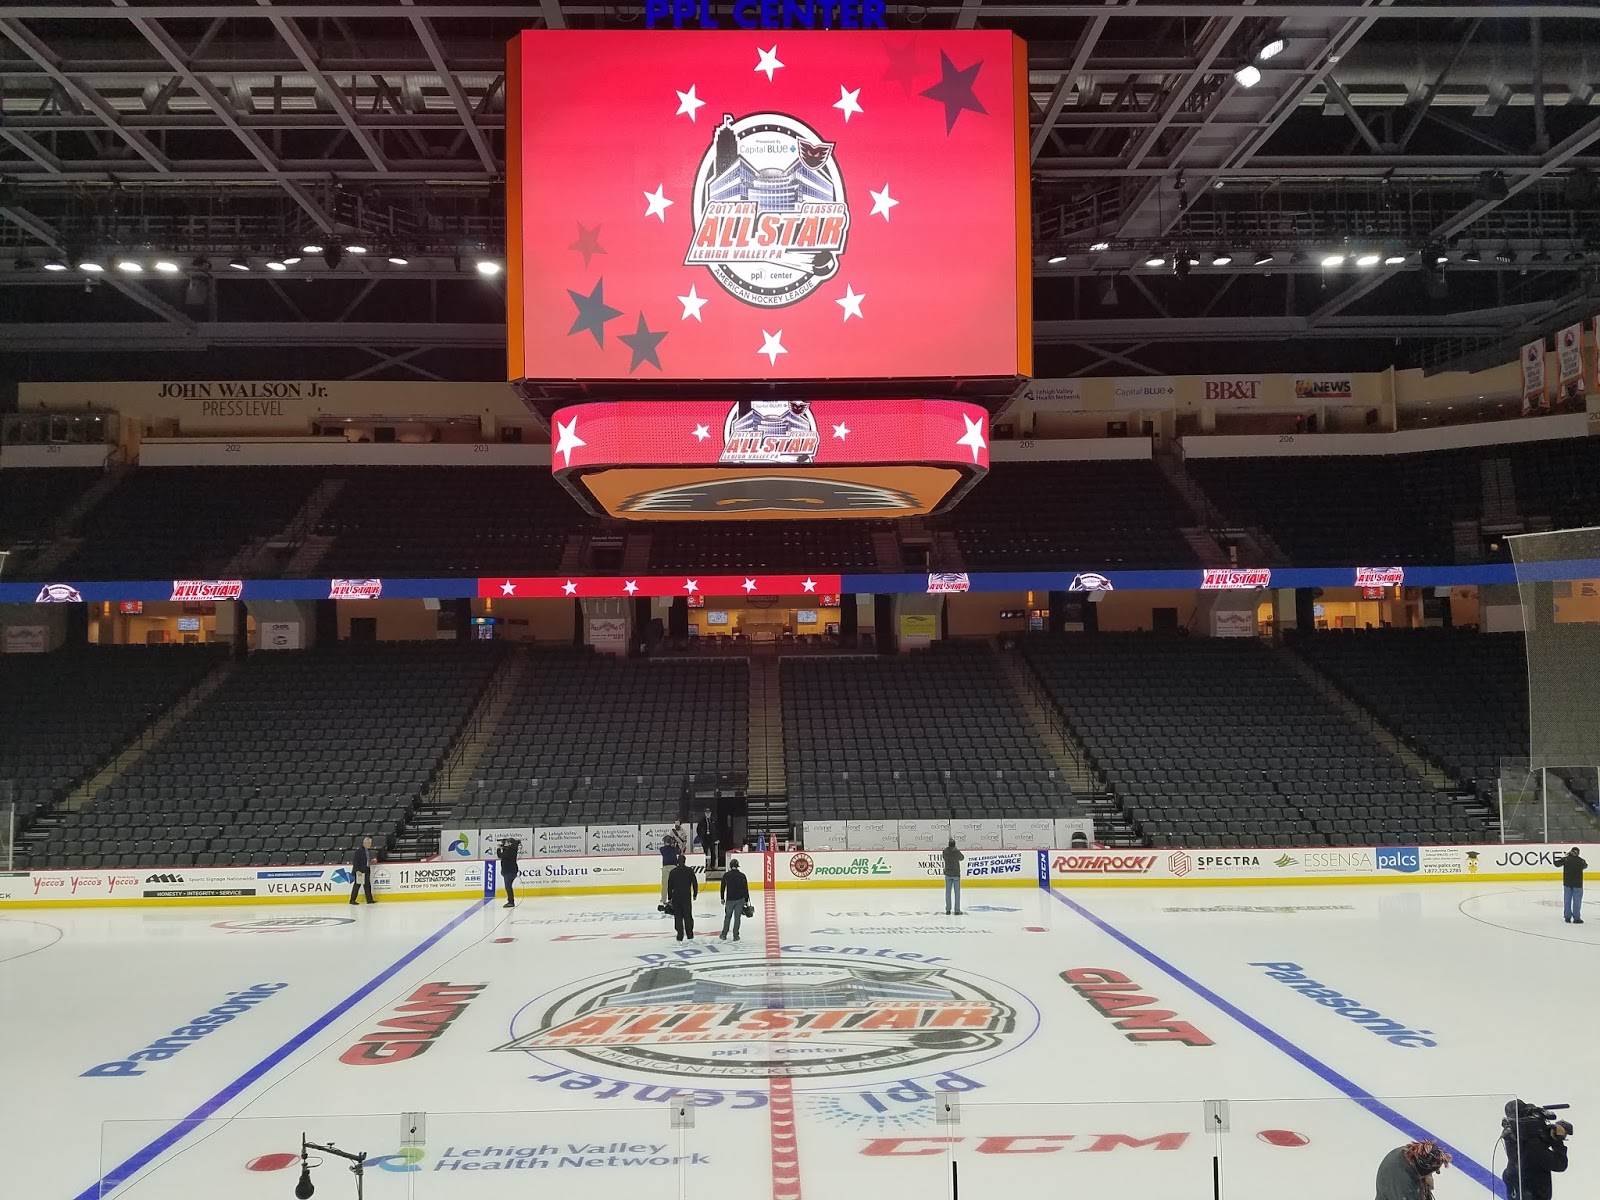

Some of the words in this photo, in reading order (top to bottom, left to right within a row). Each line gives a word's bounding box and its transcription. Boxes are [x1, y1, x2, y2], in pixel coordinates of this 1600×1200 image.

[645, 0, 719, 28] PPL
[733, 0, 887, 28] CENTER
[740, 145, 766, 154] Capital
[709, 203, 732, 214] 2017
[735, 203, 756, 214] AHL
[803, 203, 843, 214] CLASSIC
[696, 216, 751, 247] ALL
[758, 216, 845, 247] STAR
[693, 250, 729, 259] LEHIGH
[751, 270, 762, 280] ppl
[770, 271, 792, 279] center
[714, 268, 750, 299] AMERICAN
[751, 295, 783, 304] HOCKEY
[785, 280, 814, 301] LEAGUE
[158, 383, 212, 398] JOHN
[217, 383, 302, 398] WALSON
[307, 383, 328, 398] Jr.
[1056, 388, 1073, 396] Valley
[1115, 388, 1142, 396] Capital
[1204, 380, 1261, 400] BB&T
[1313, 381, 1351, 393] NEWS
[203, 401, 243, 416] PRESS
[245, 401, 284, 416] LEVEL
[226, 444, 241, 452] 202
[473, 444, 488, 452] 203
[727, 438, 761, 453] ALL
[763, 438, 816, 453] STAR
[1019, 440, 1034, 448] 205
[1206, 574, 1228, 584] ALL
[1231, 573, 1268, 584] STAR
[1358, 574, 1375, 582] ALL
[1377, 574, 1402, 582] STAR
[175, 586, 199, 596] ALL
[202, 586, 239, 596] STAR
[333, 586, 350, 594] ALL
[352, 586, 380, 594] STAR
[851, 858, 869, 866] AIR
[990, 858, 1021, 866] SOURCE
[1051, 855, 1159, 875] ROTHROCK!
[1198, 856, 1260, 866] SPECTRA
[1304, 853, 1372, 868] ESSENSA
[1378, 852, 1417, 869] palcs
[1496, 851, 1567, 867] JOCKE
[399, 870, 409, 883] 11
[414, 869, 456, 877] NONSTOP
[545, 864, 588, 877] Subaru
[815, 866, 869, 875] PRODUCTS
[966, 868, 988, 876] FOR
[990, 864, 1021, 874] NEWS
[33, 877, 65, 895] Yocco's
[70, 876, 102, 894] Yocco's
[107, 875, 139, 893] Yocco's
[268, 883, 332, 893] VELASPAN
[635, 945, 720, 964] ppl
[780, 943, 952, 964] center
[708, 971, 768, 979] Capital
[599, 1006, 666, 1014] 2017
[1058, 967, 1217, 1048] GIANT
[1246, 961, 1438, 1048] Panasonic
[78, 981, 289, 1077] Panasonic
[338, 981, 490, 1066] GIANT
[546, 1012, 721, 1037] ALL
[736, 1009, 994, 1030] STAR
[528, 1035, 645, 1045] LEHIGH
[712, 1047, 747, 1056] ppl
[591, 1050, 701, 1073] AMERICAN
[710, 1065, 813, 1075] HOCKEY
[825, 1053, 919, 1071] LEAGUE
[527, 1070, 769, 1109] center
[443, 1144, 559, 1158] Lehigh
[564, 1142, 669, 1157] Valley
[859, 1131, 1192, 1157] CCM
[433, 1157, 554, 1173] Health
[558, 1152, 712, 1169] Network
